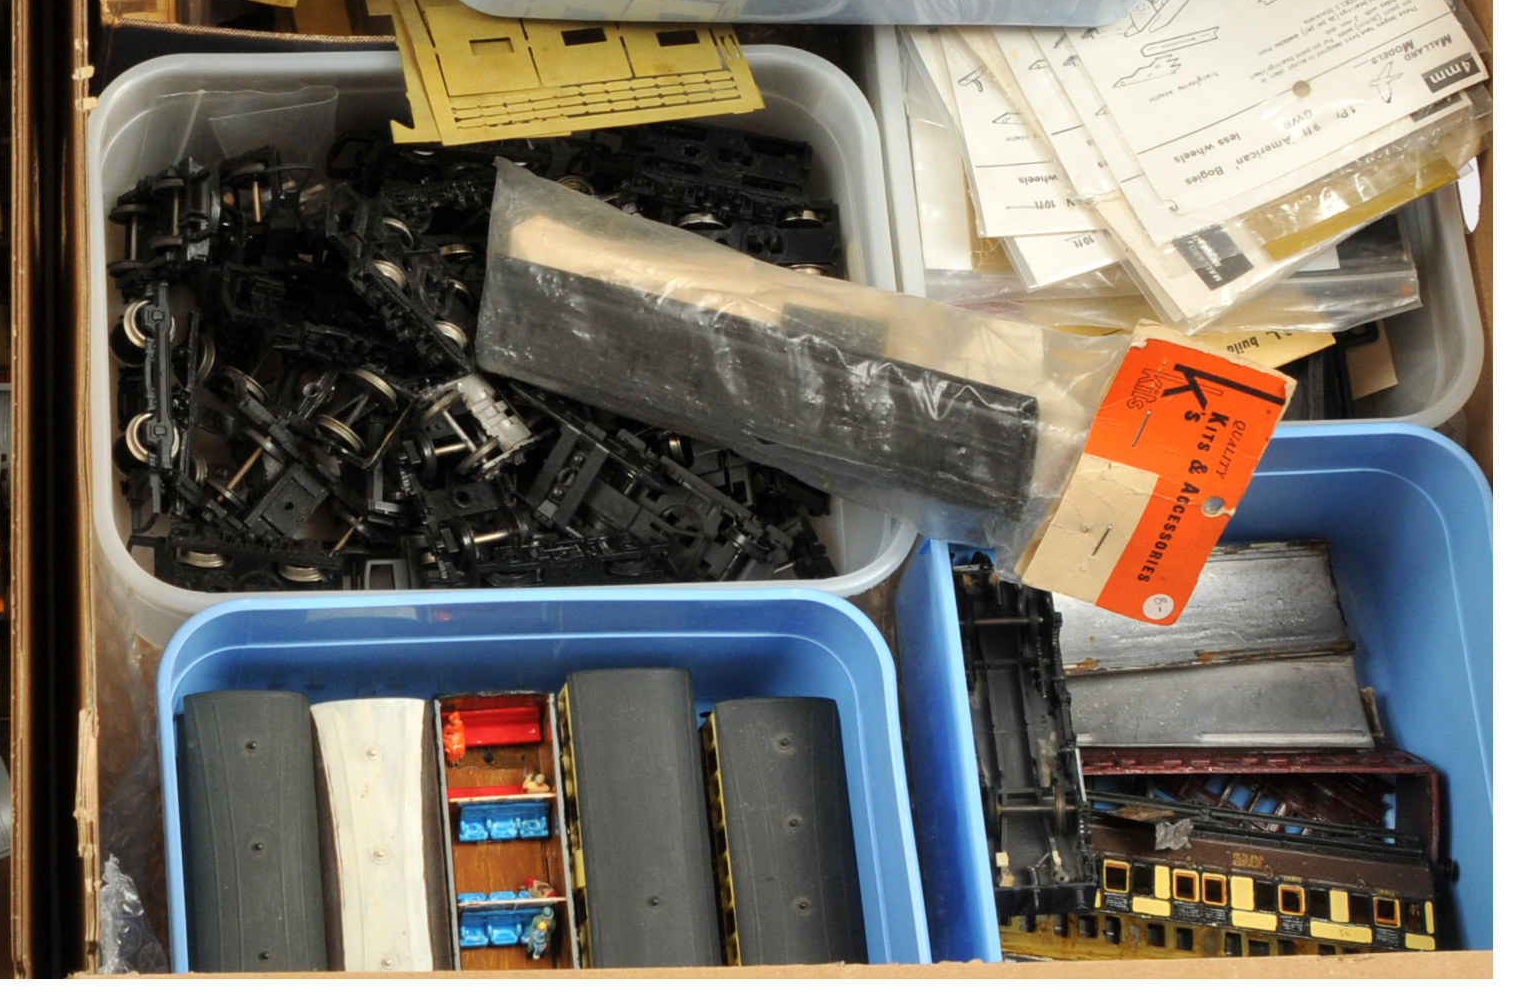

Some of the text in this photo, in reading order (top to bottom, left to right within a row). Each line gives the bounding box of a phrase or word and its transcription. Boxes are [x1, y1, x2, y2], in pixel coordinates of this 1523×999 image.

[1360, 25, 1374, 36] have
[1370, 39, 1415, 66] MODELS
[1402, 32, 1453, 62] MALLARD
[1429, 58, 1473, 85] 4mm
[1282, 106, 1313, 131] GWR
[1172, 132, 1241, 164] less wheels
[1018, 174, 1058, 185] wheels
[1184, 165, 1224, 187] Bogies
[1216, 420, 1246, 480] QUALITY
[1137, 411, 1230, 583] KITS & ACCESSORIES
